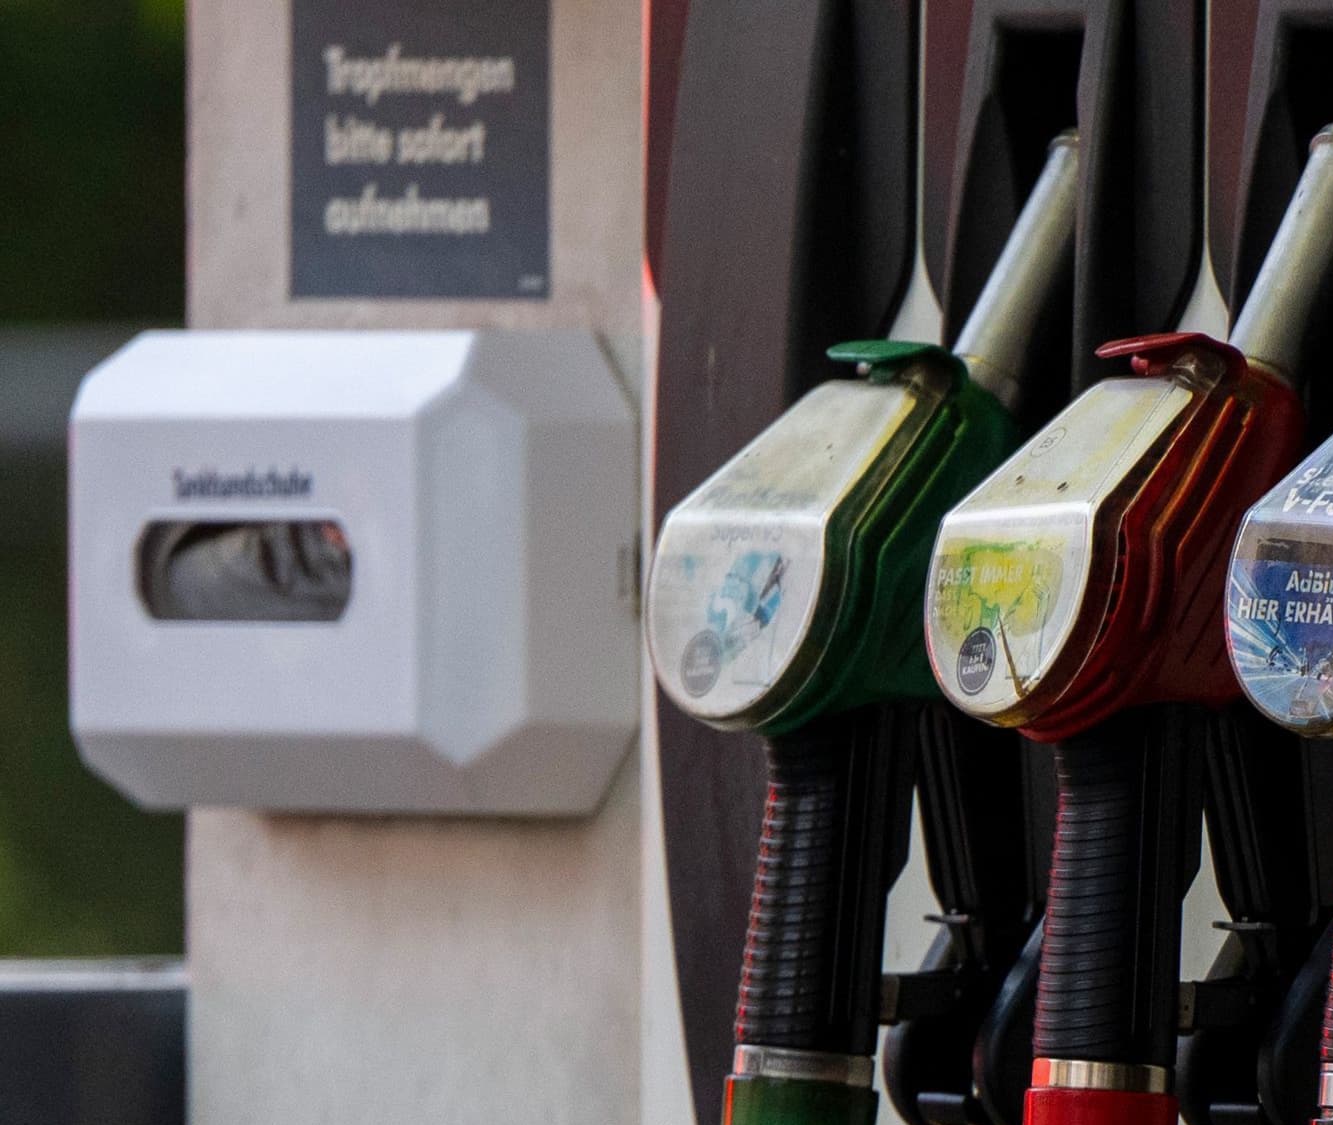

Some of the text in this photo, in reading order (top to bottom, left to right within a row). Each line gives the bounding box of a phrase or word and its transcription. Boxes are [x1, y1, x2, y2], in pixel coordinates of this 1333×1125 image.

[324, 43, 515, 105] Tropfmengen
[324, 113, 487, 165] bitte sofort
[324, 182, 490, 236] aufnehmen
[1237, 597, 1280, 621] HIER
